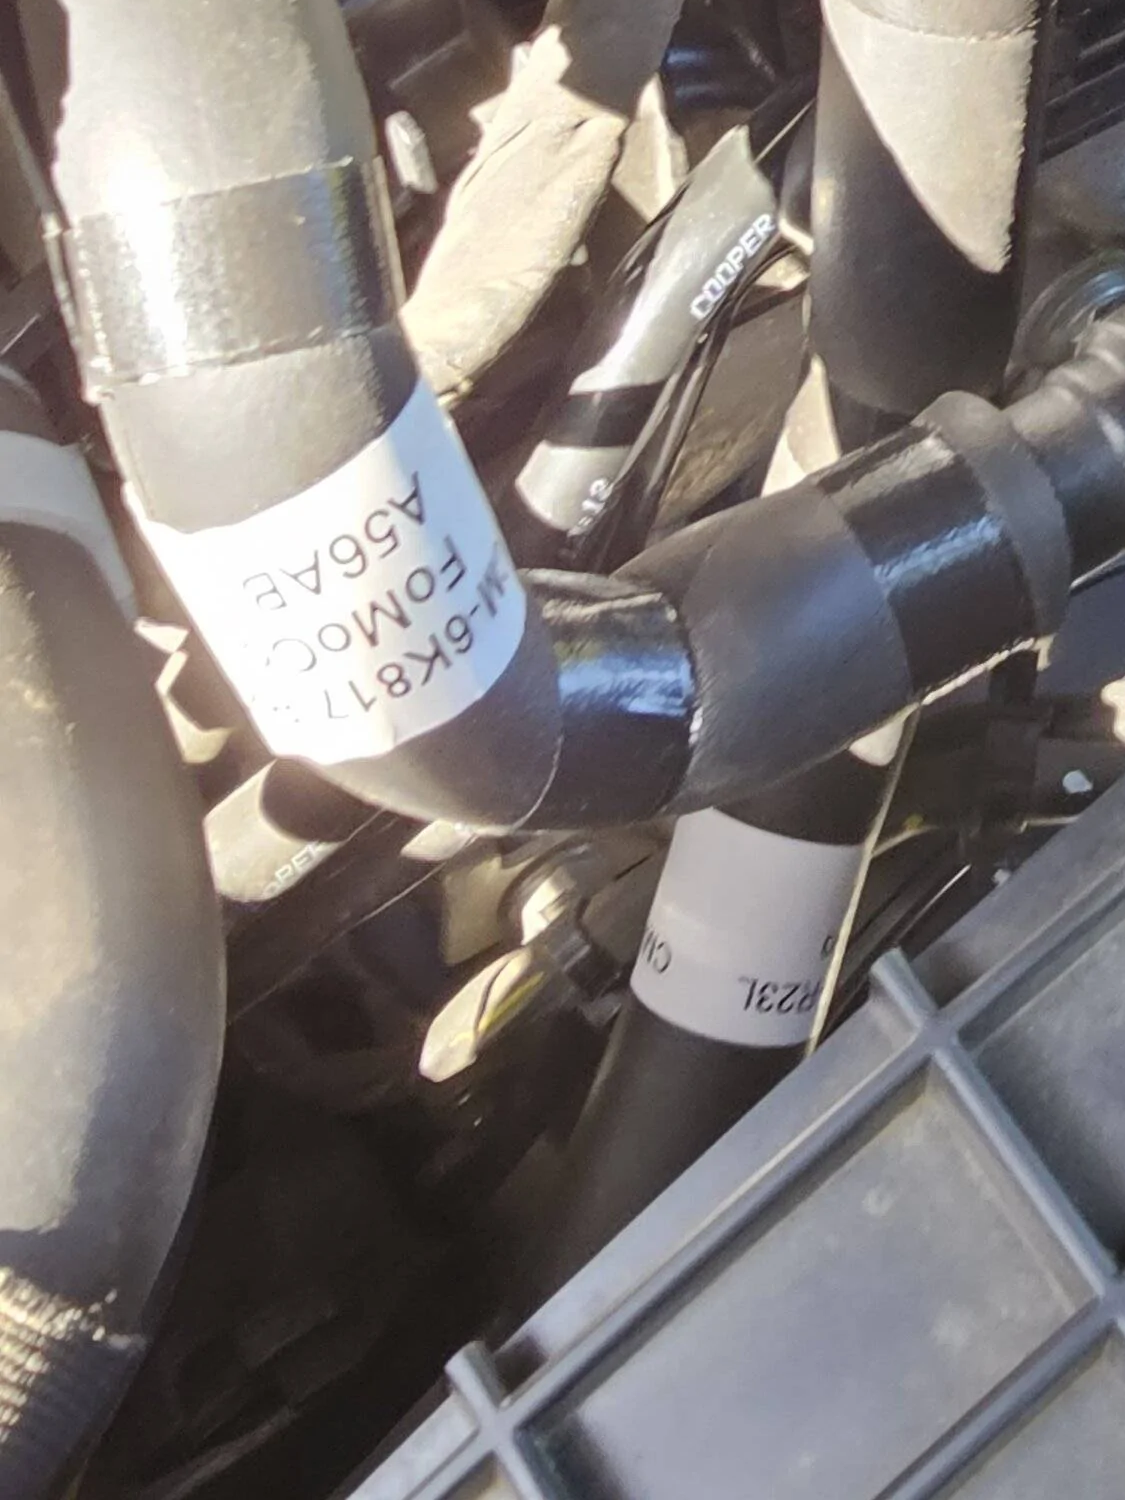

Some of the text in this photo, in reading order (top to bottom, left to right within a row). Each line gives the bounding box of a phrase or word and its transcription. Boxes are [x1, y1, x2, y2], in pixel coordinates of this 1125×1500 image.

[690, 213, 776, 321] COOPER
[242, 471, 426, 611] A56AE
[262, 534, 467, 673] FoMoC
